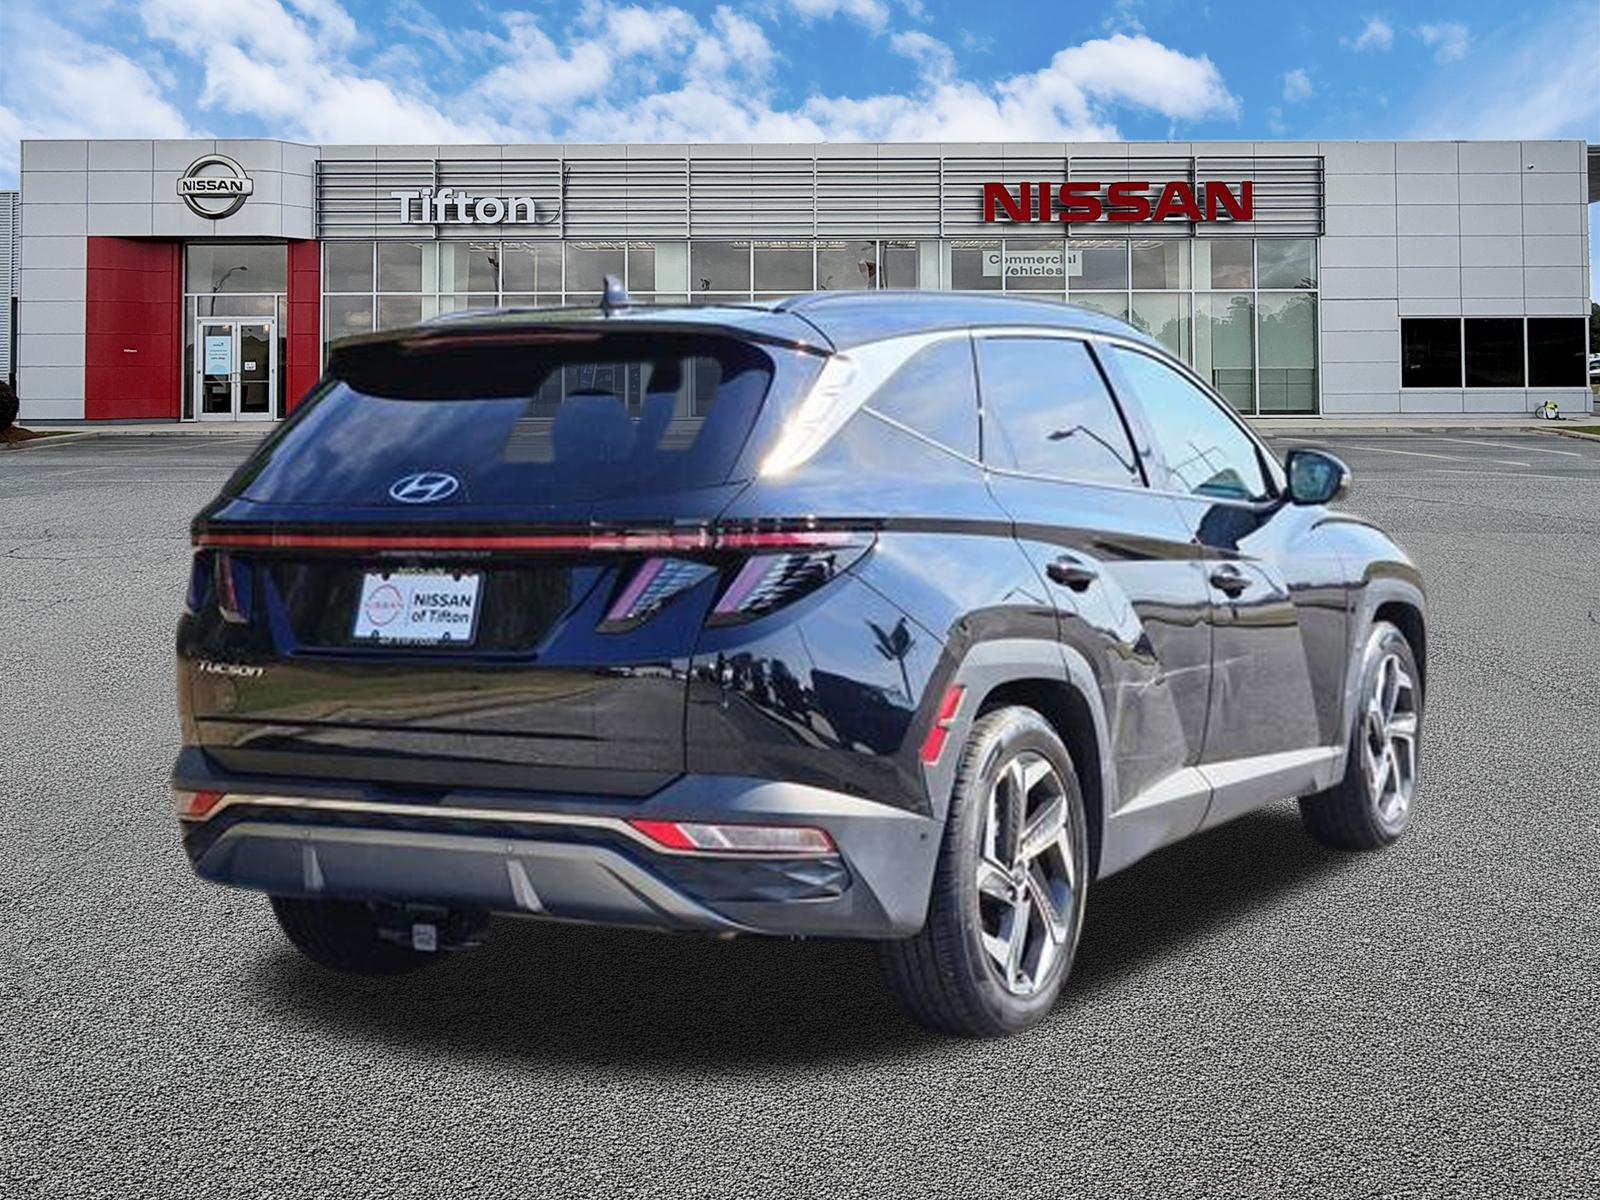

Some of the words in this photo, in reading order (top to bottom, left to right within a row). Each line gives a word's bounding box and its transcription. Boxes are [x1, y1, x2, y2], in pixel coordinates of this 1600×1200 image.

[182, 180, 243, 192] NISSAN
[391, 188, 536, 224] Tifton
[983, 180, 1253, 222] NISSAN
[413, 593, 472, 608] NISSAN
